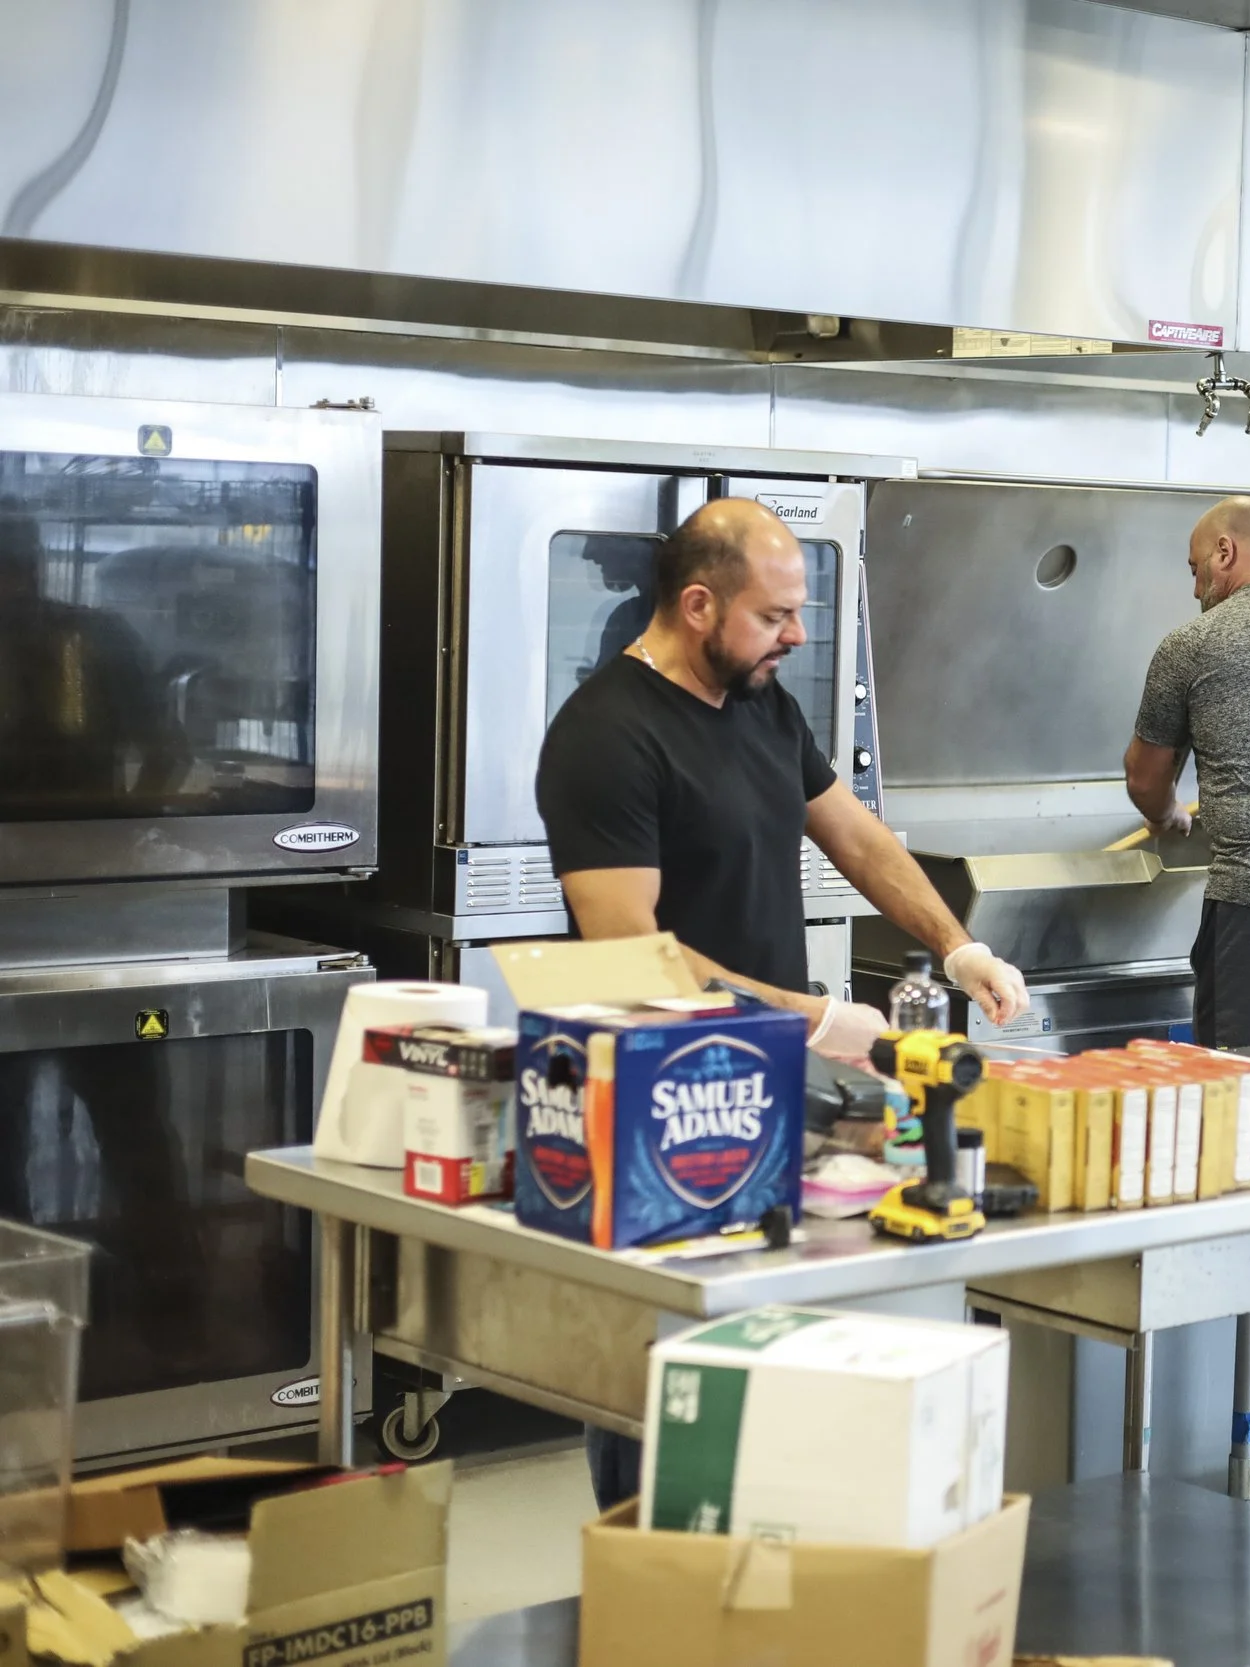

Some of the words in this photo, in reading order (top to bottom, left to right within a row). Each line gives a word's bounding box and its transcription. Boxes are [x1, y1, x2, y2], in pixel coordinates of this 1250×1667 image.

[775, 505, 818, 519] Garland
[280, 831, 354, 844] COMBITHERM
[399, 1041, 449, 1067] VINYL
[651, 1072, 774, 1119] SAMUEL
[526, 1106, 584, 1146] ADAM
[660, 1107, 762, 1151] ADAMS
[277, 1384, 321, 1402] COMBIT
[248, 1604, 428, 1667] FP-IMDC16-PPB
